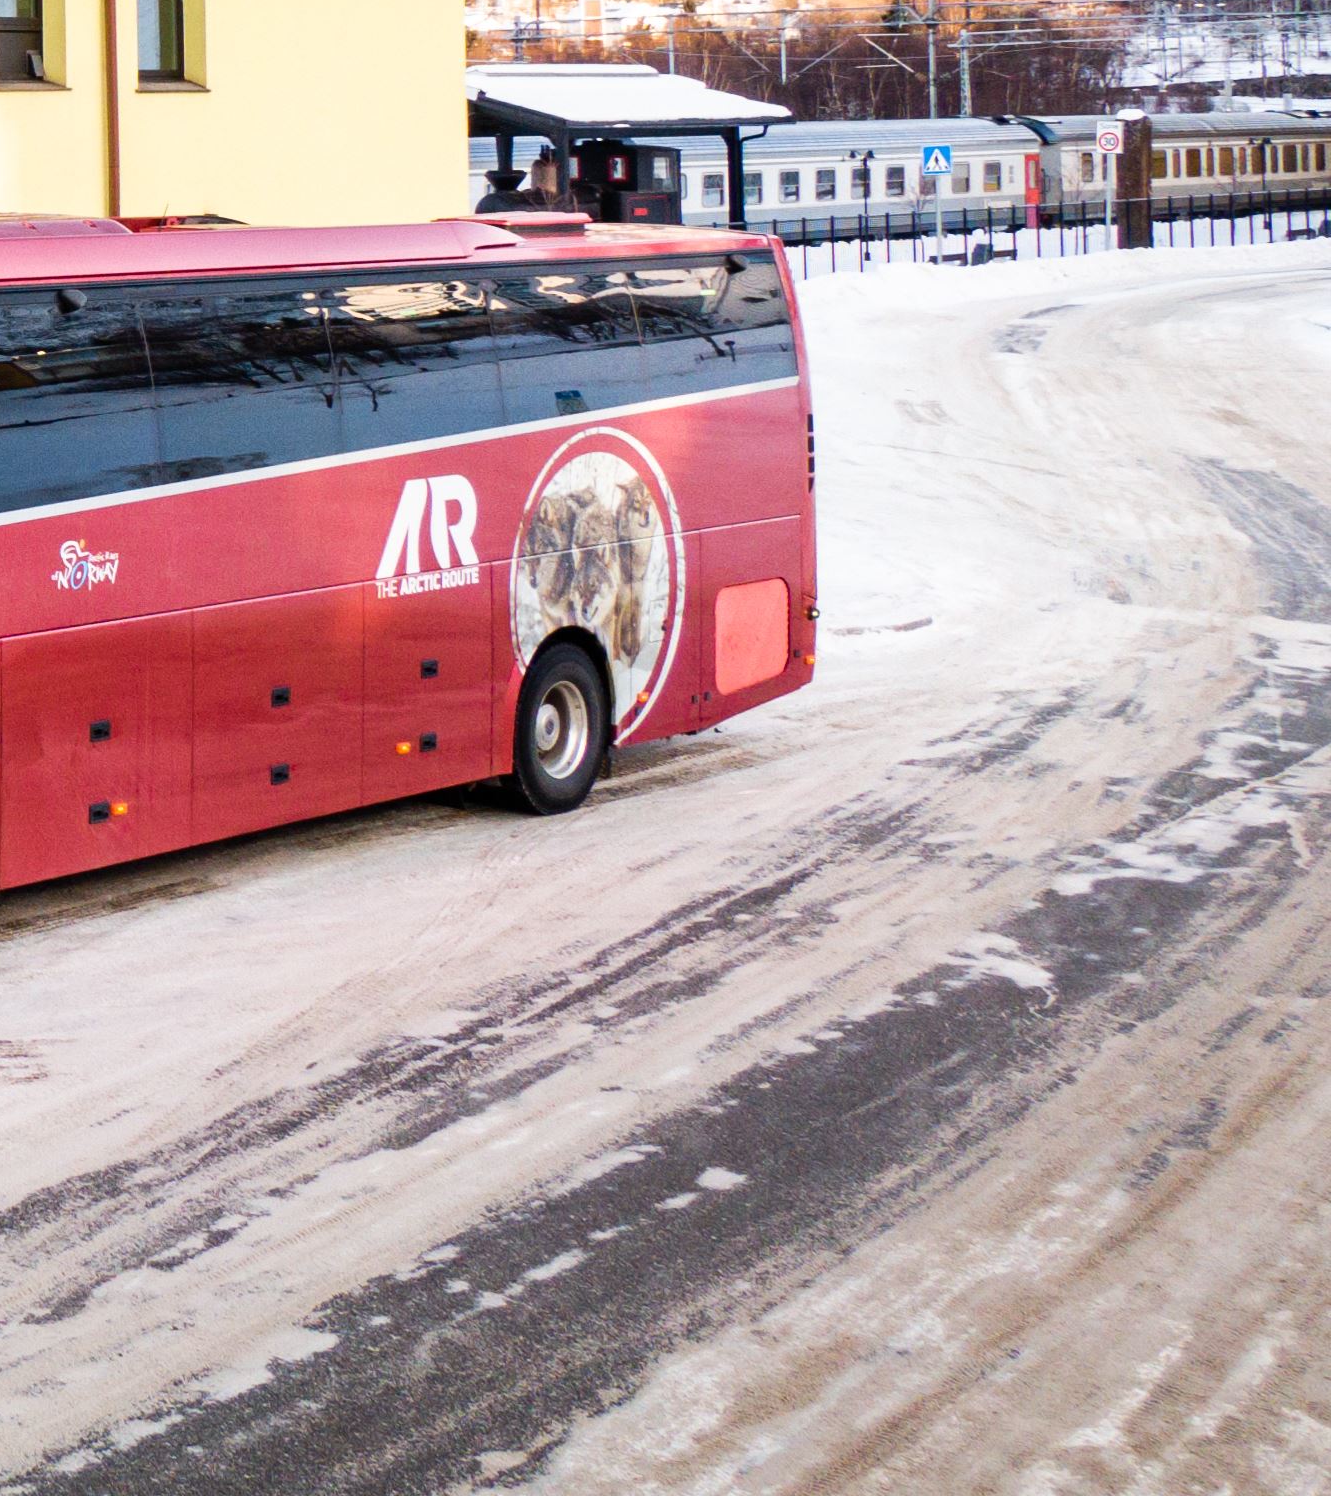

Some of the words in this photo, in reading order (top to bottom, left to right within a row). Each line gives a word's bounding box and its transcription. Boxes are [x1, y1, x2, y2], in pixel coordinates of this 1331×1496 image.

[1103, 137, 1116, 146] 30
[375, 474, 480, 580] AR
[375, 580, 399, 600] THE
[400, 573, 442, 596] ARCTIC
[442, 566, 480, 589] ROUTE
